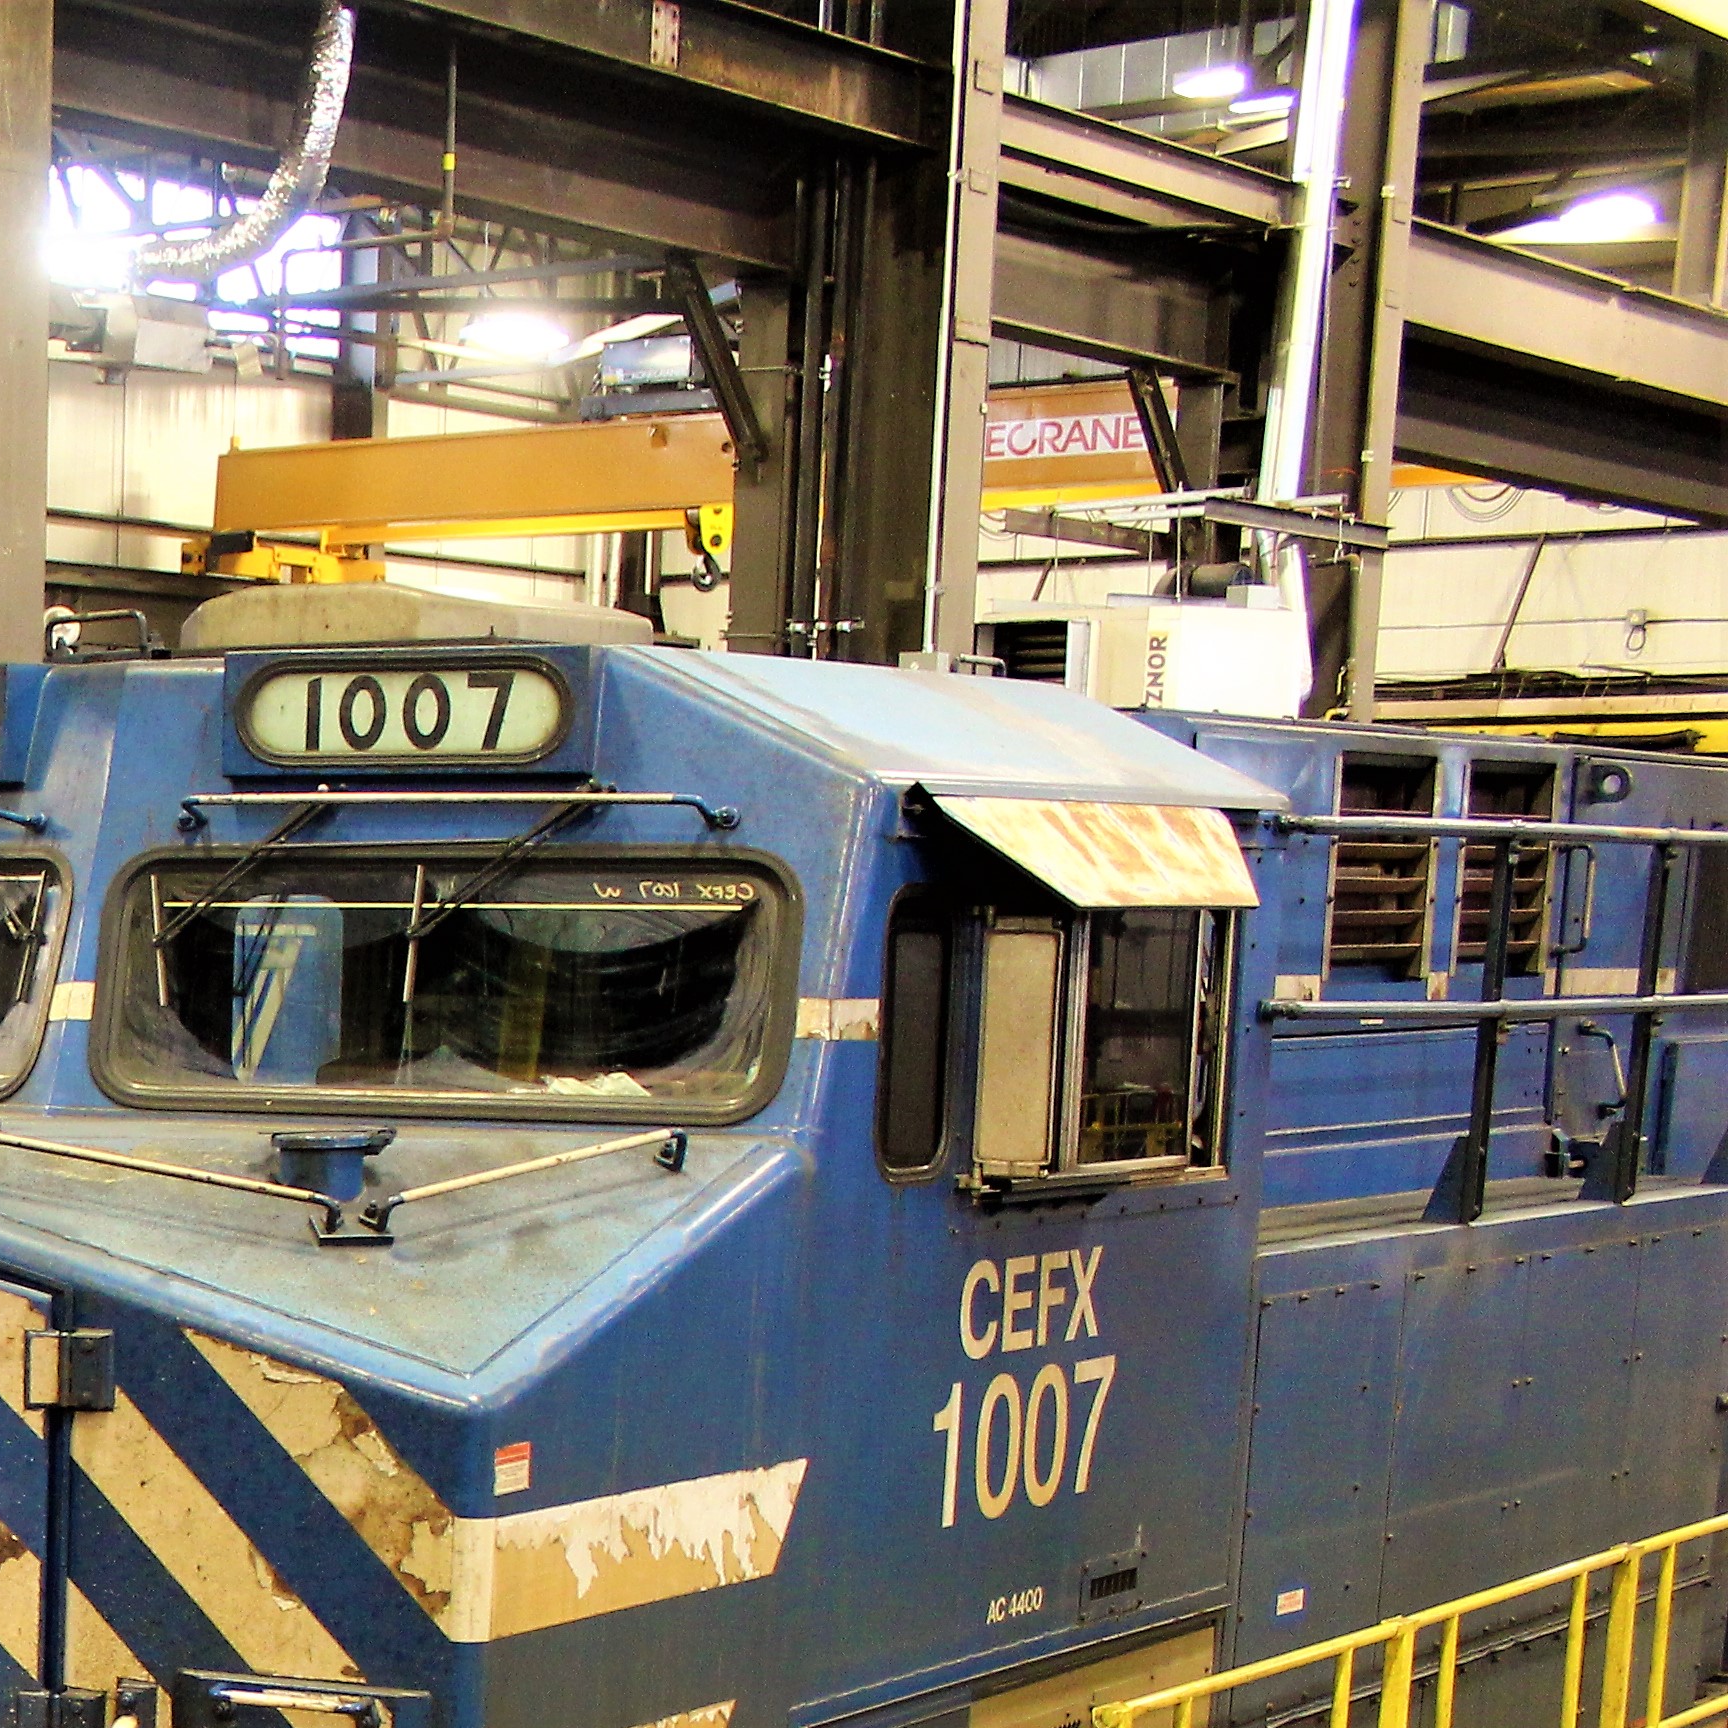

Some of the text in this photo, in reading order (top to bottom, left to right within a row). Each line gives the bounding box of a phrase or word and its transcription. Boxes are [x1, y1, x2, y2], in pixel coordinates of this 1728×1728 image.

[985, 416, 1144, 457] ECRANE
[1144, 636, 1168, 705] ZNOR
[305, 671, 517, 751] 1007
[960, 1245, 1104, 1361] CEFX
[932, 1354, 1117, 1528] 1007
[986, 1585, 1044, 1625] AC 4400
